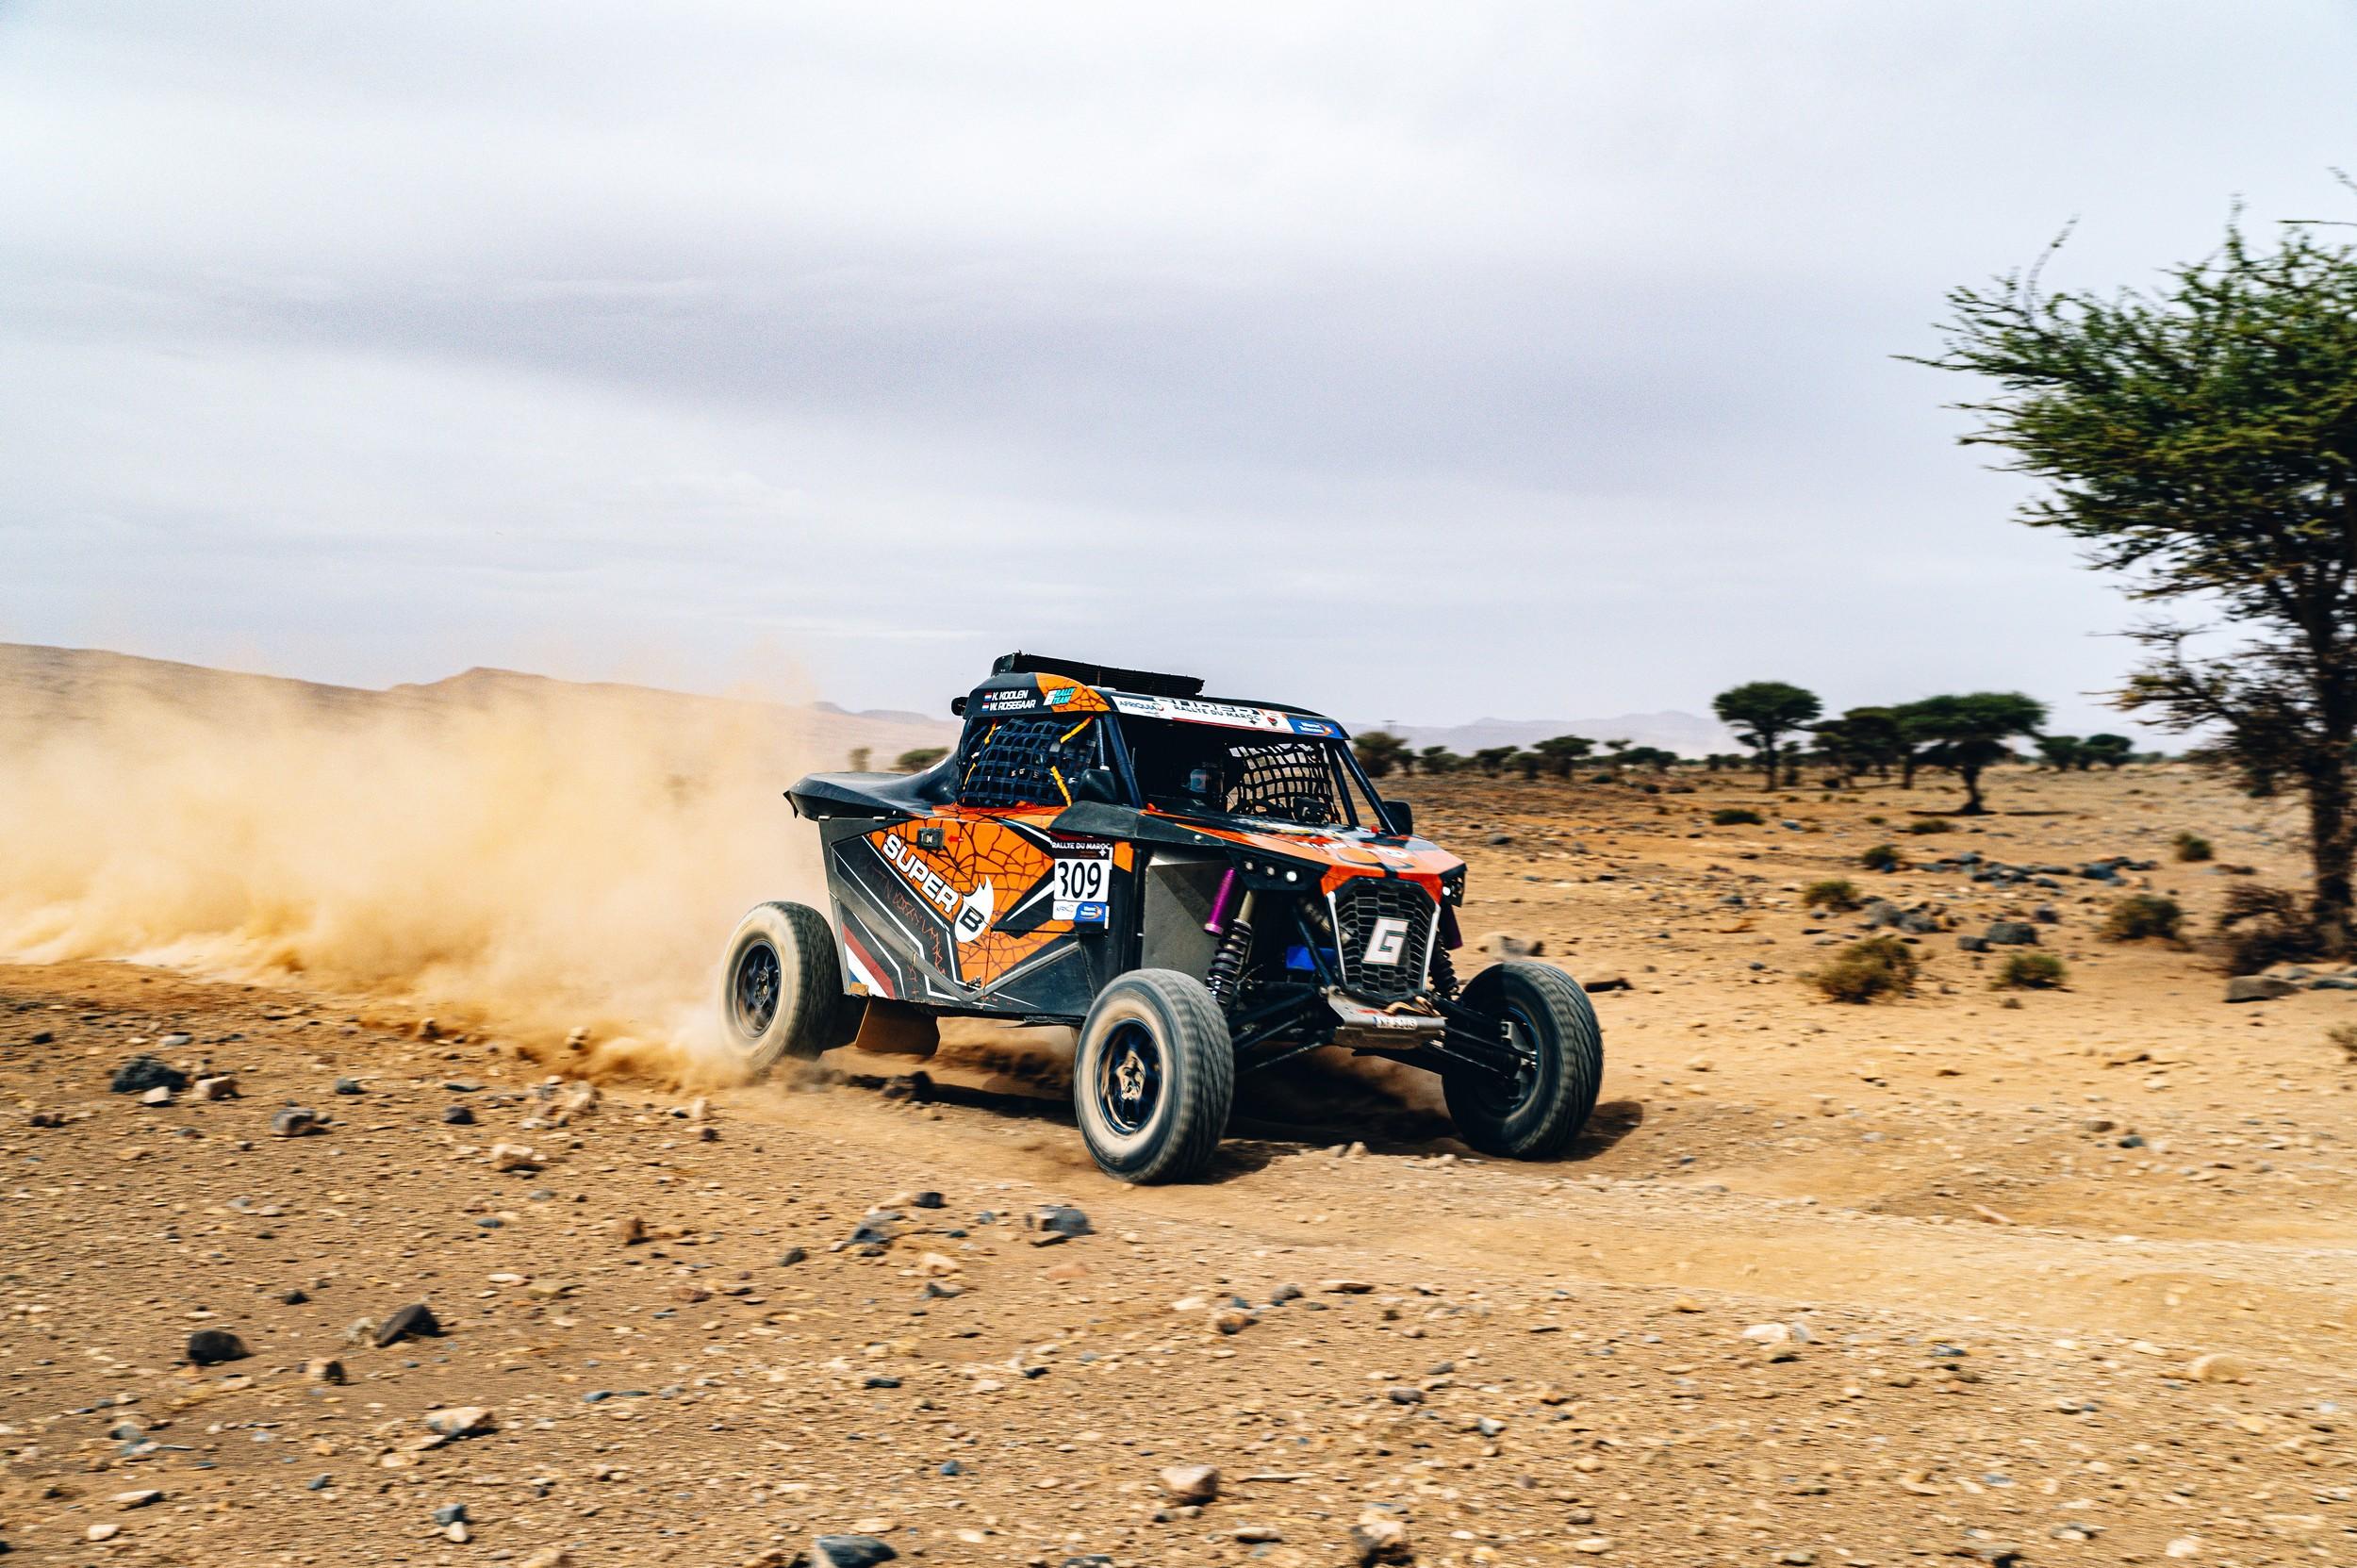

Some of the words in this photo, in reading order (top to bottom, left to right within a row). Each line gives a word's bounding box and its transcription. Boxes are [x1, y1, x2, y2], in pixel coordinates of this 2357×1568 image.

[999, 689, 1029, 701] KOOLEN
[997, 700, 1036, 711] ROSEGAAR
[1227, 711, 1261, 721] MAROC
[1051, 841, 1075, 850] RALLYE
[882, 834, 959, 914] SUPER
[1057, 861, 1102, 900] 309
